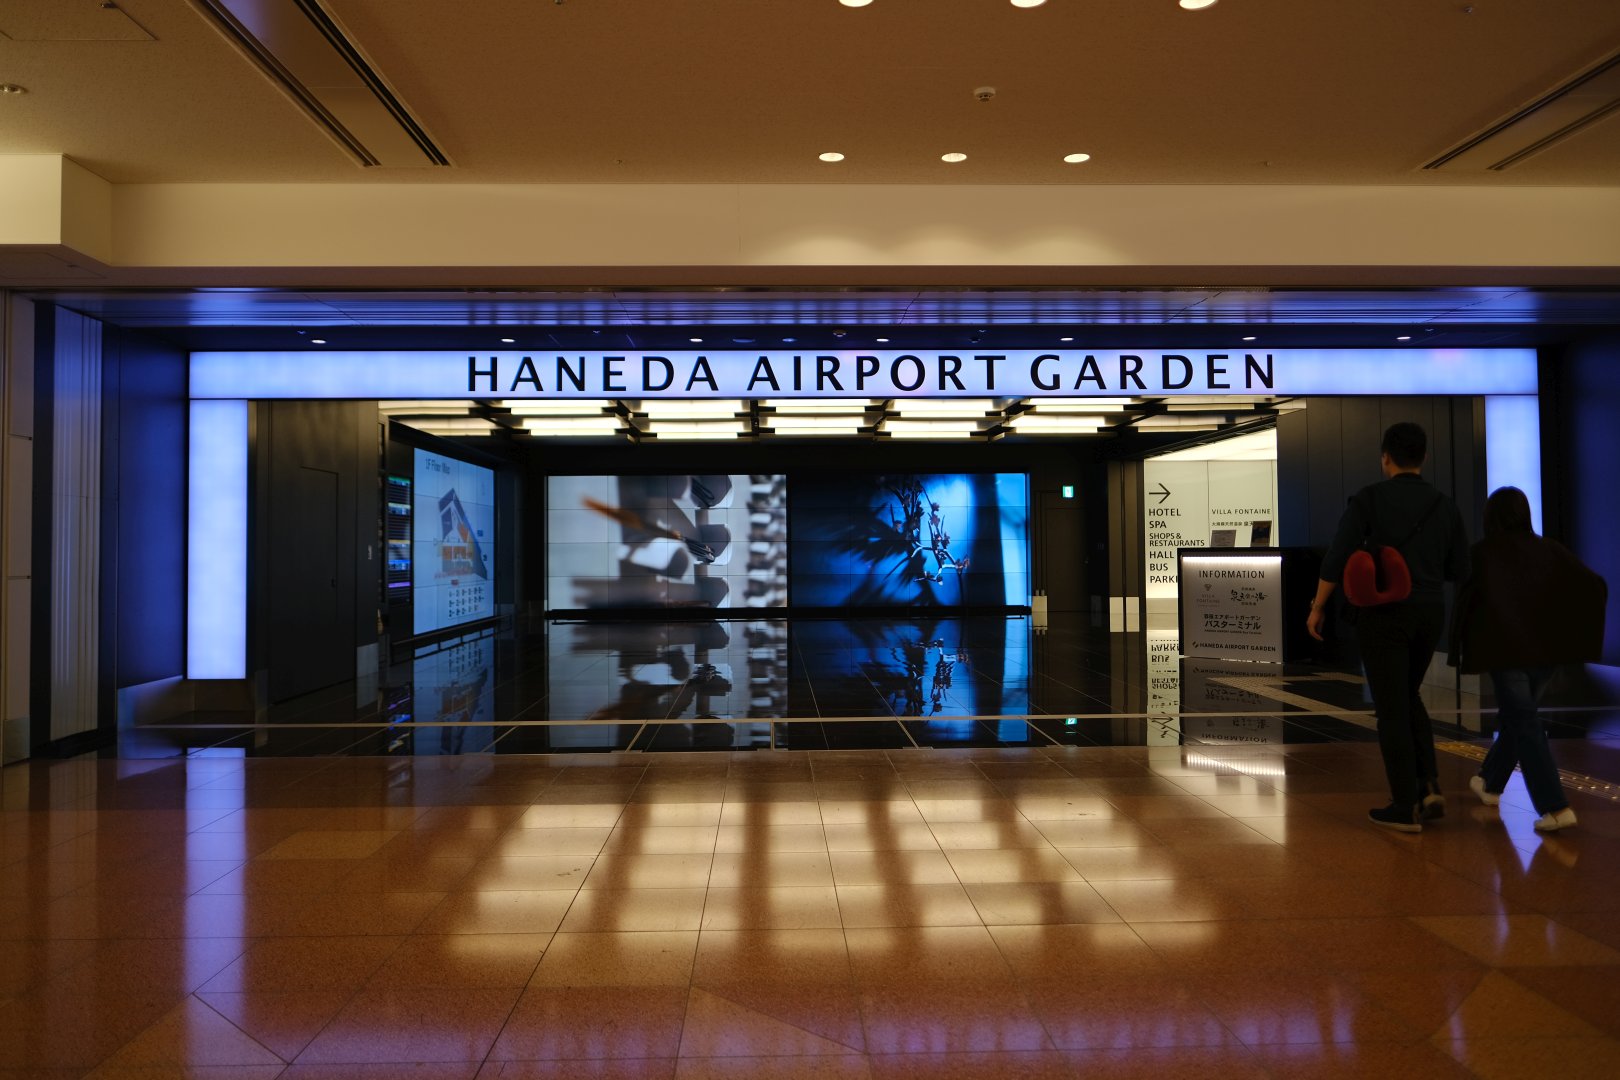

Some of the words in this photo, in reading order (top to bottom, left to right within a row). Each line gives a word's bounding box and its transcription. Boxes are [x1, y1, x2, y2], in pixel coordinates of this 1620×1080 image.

[467, 355, 720, 392] HANEDA
[746, 354, 1007, 392] AIRPORT
[1029, 353, 1275, 391] GARDEN
[1148, 508, 1182, 517] HOTEL
[1149, 520, 1167, 529] SPA
[1149, 532, 1175, 540] SHOPS
[1175, 532, 1182, 540] &
[1149, 539, 1205, 547] RESTAURANTS
[1149, 551, 1175, 559] HALL
[1149, 563, 1169, 572] BUS
[1198, 570, 1265, 579] INFORMATION
[1204, 620, 1261, 630] バスターミナル
